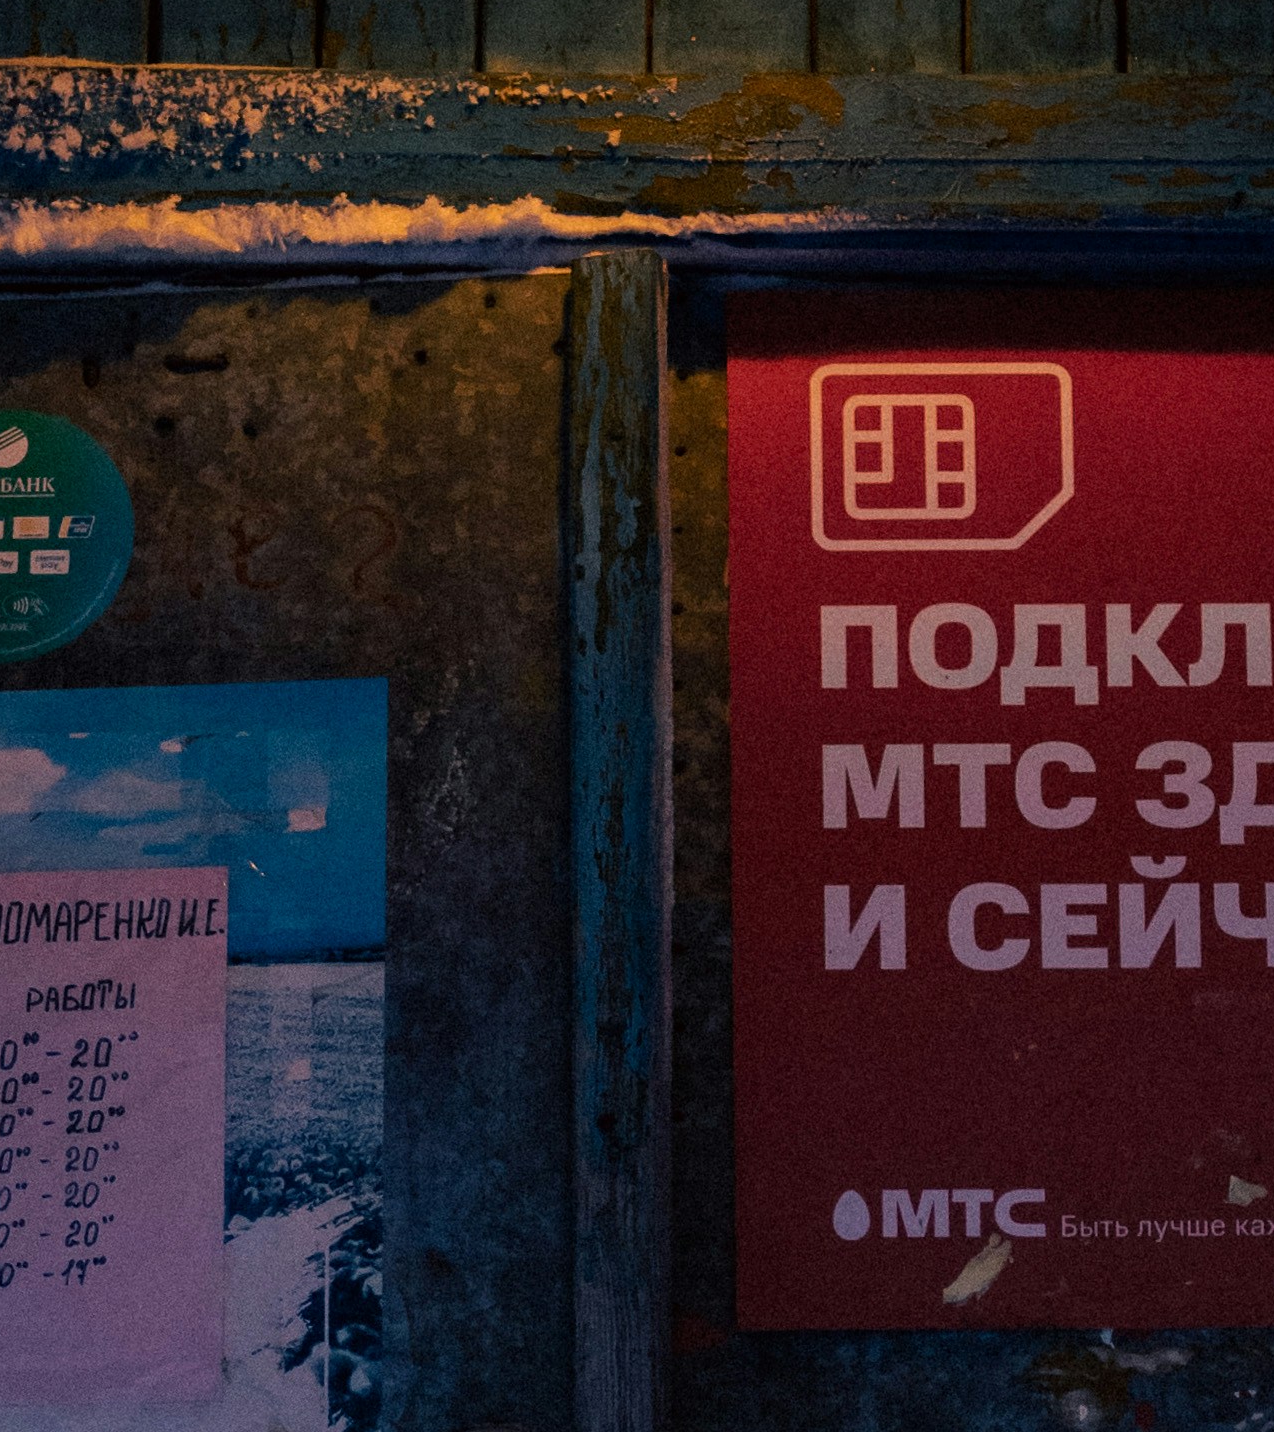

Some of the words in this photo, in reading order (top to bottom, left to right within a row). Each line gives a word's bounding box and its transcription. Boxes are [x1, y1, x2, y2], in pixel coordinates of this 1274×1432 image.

[821, 739, 1098, 830] МТС
[823, 883, 908, 971] И
[26, 978, 137, 1013] РАБОТЫ
[881, 1188, 1047, 1239] МТС
[1061, 1214, 1129, 1239] Быть
[1137, 1218, 1226, 1244] лучше
